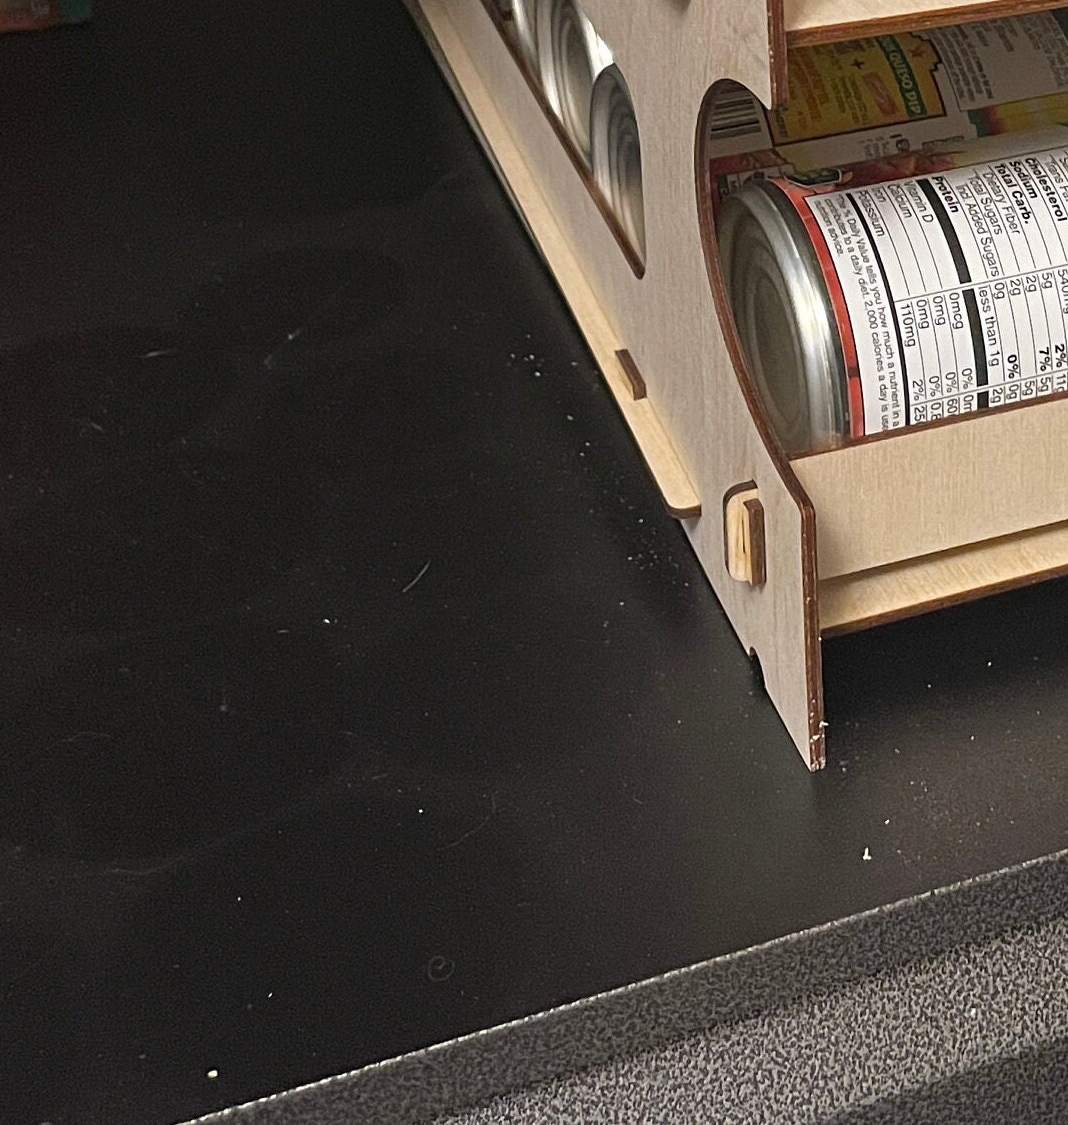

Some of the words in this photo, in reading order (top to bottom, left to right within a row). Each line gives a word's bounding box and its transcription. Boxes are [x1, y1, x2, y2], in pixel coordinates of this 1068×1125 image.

[932, 176, 959, 213] Protein
[1009, 161, 1038, 199] Sodium
[1025, 157, 1068, 222] Cholesterol
[847, 218, 861, 237] Daily
[969, 177, 986, 196] Total
[981, 197, 1002, 235] Sugars
[1009, 279, 1021, 296] 2g
[850, 255, 862, 276] daily
[857, 239, 871, 264] Value
[994, 164, 1017, 188] Total
[1012, 190, 1032, 224] Carb.
[1042, 272, 1053, 290] 5g
[1054, 343, 1068, 368] 2%
[866, 265, 877, 284] tells
[887, 183, 912, 219] Calcium
[932, 296, 946, 326] 0mg
[945, 371, 958, 393] 0%
[902, 180, 927, 211] Vitamin
[921, 213, 934, 223] D
[949, 292, 964, 330] 0mcg
[961, 368, 974, 390] 0%
[1002, 206, 1020, 234] Fiber
[1026, 276, 1038, 292] 2g
[1039, 346, 1053, 372] 7%
[857, 190, 886, 237] Potassium
[900, 304, 916, 347] 110mg
[912, 379, 925, 401] 2%
[870, 286, 882, 305] you
[965, 202, 988, 234] Added
[981, 236, 999, 277] Sugars
[994, 283, 1005, 300] 0g
[1007, 354, 1020, 379] 0%
[978, 286, 991, 313] less
[864, 301, 878, 329] 2,000
[878, 307, 888, 328] how
[883, 331, 894, 359] much
[986, 316, 998, 347] than
[872, 332, 884, 372] calories
[916, 299, 930, 329] 0mg
[929, 375, 941, 398] 0%
[988, 351, 1000, 367] 1g
[878, 381, 889, 401] day
[889, 371, 899, 408] nutrient
[990, 387, 1003, 404] 2g
[881, 404, 888, 413] is
[892, 410, 900, 419] in
